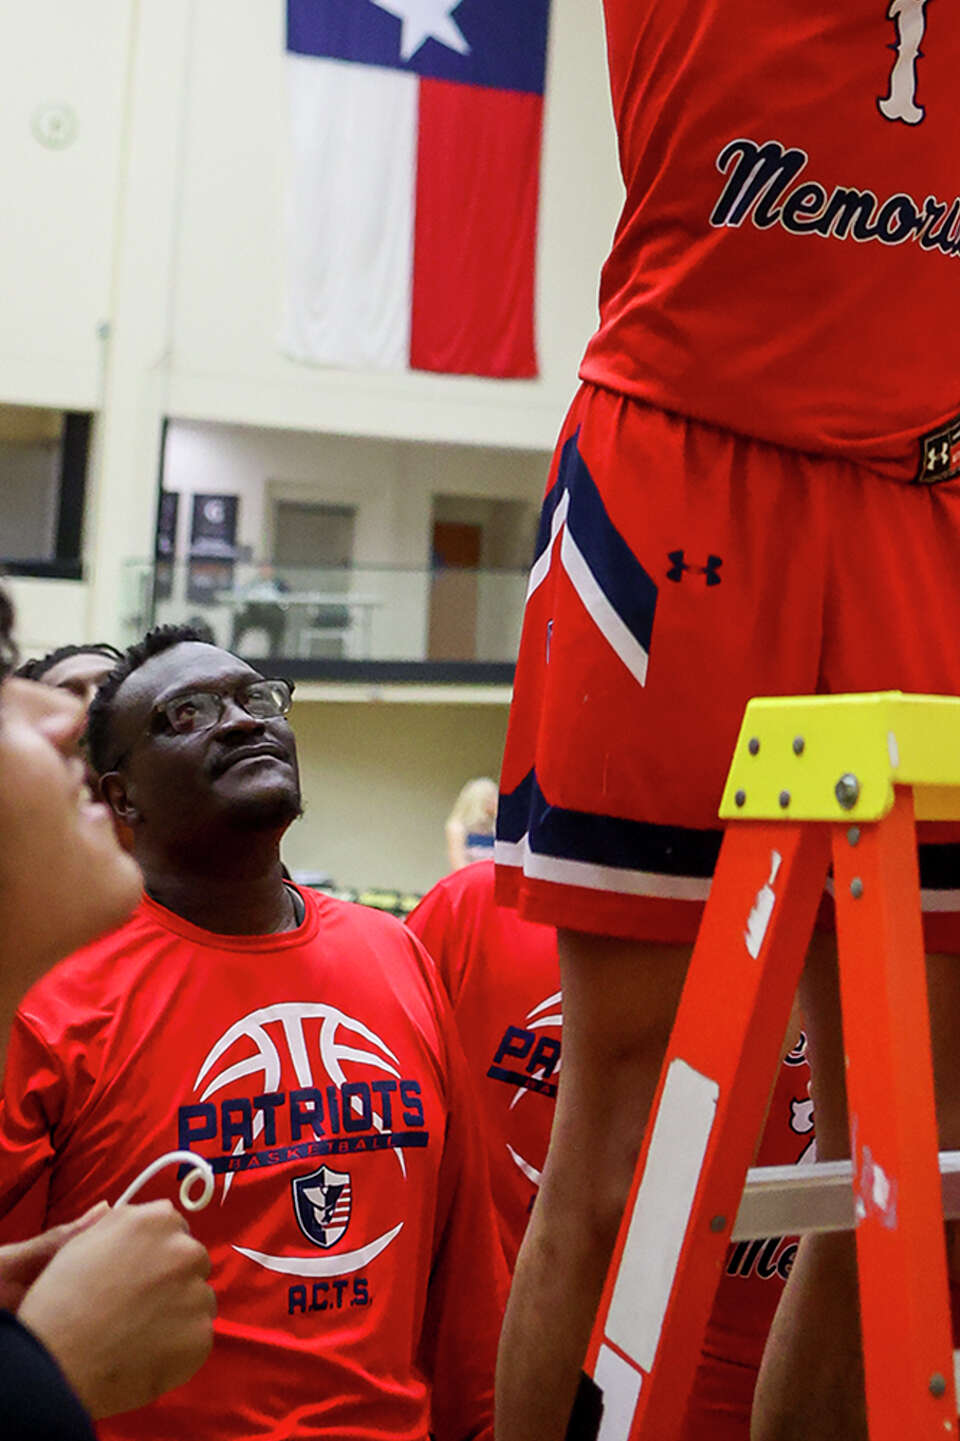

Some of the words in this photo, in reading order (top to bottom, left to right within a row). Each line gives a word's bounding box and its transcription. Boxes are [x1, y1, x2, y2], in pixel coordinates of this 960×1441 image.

[177, 1080, 425, 1154] PATRIOTS
[229, 1136, 396, 1170] BASKETBALL
[288, 1277, 373, 1314] A.C.T.S.
